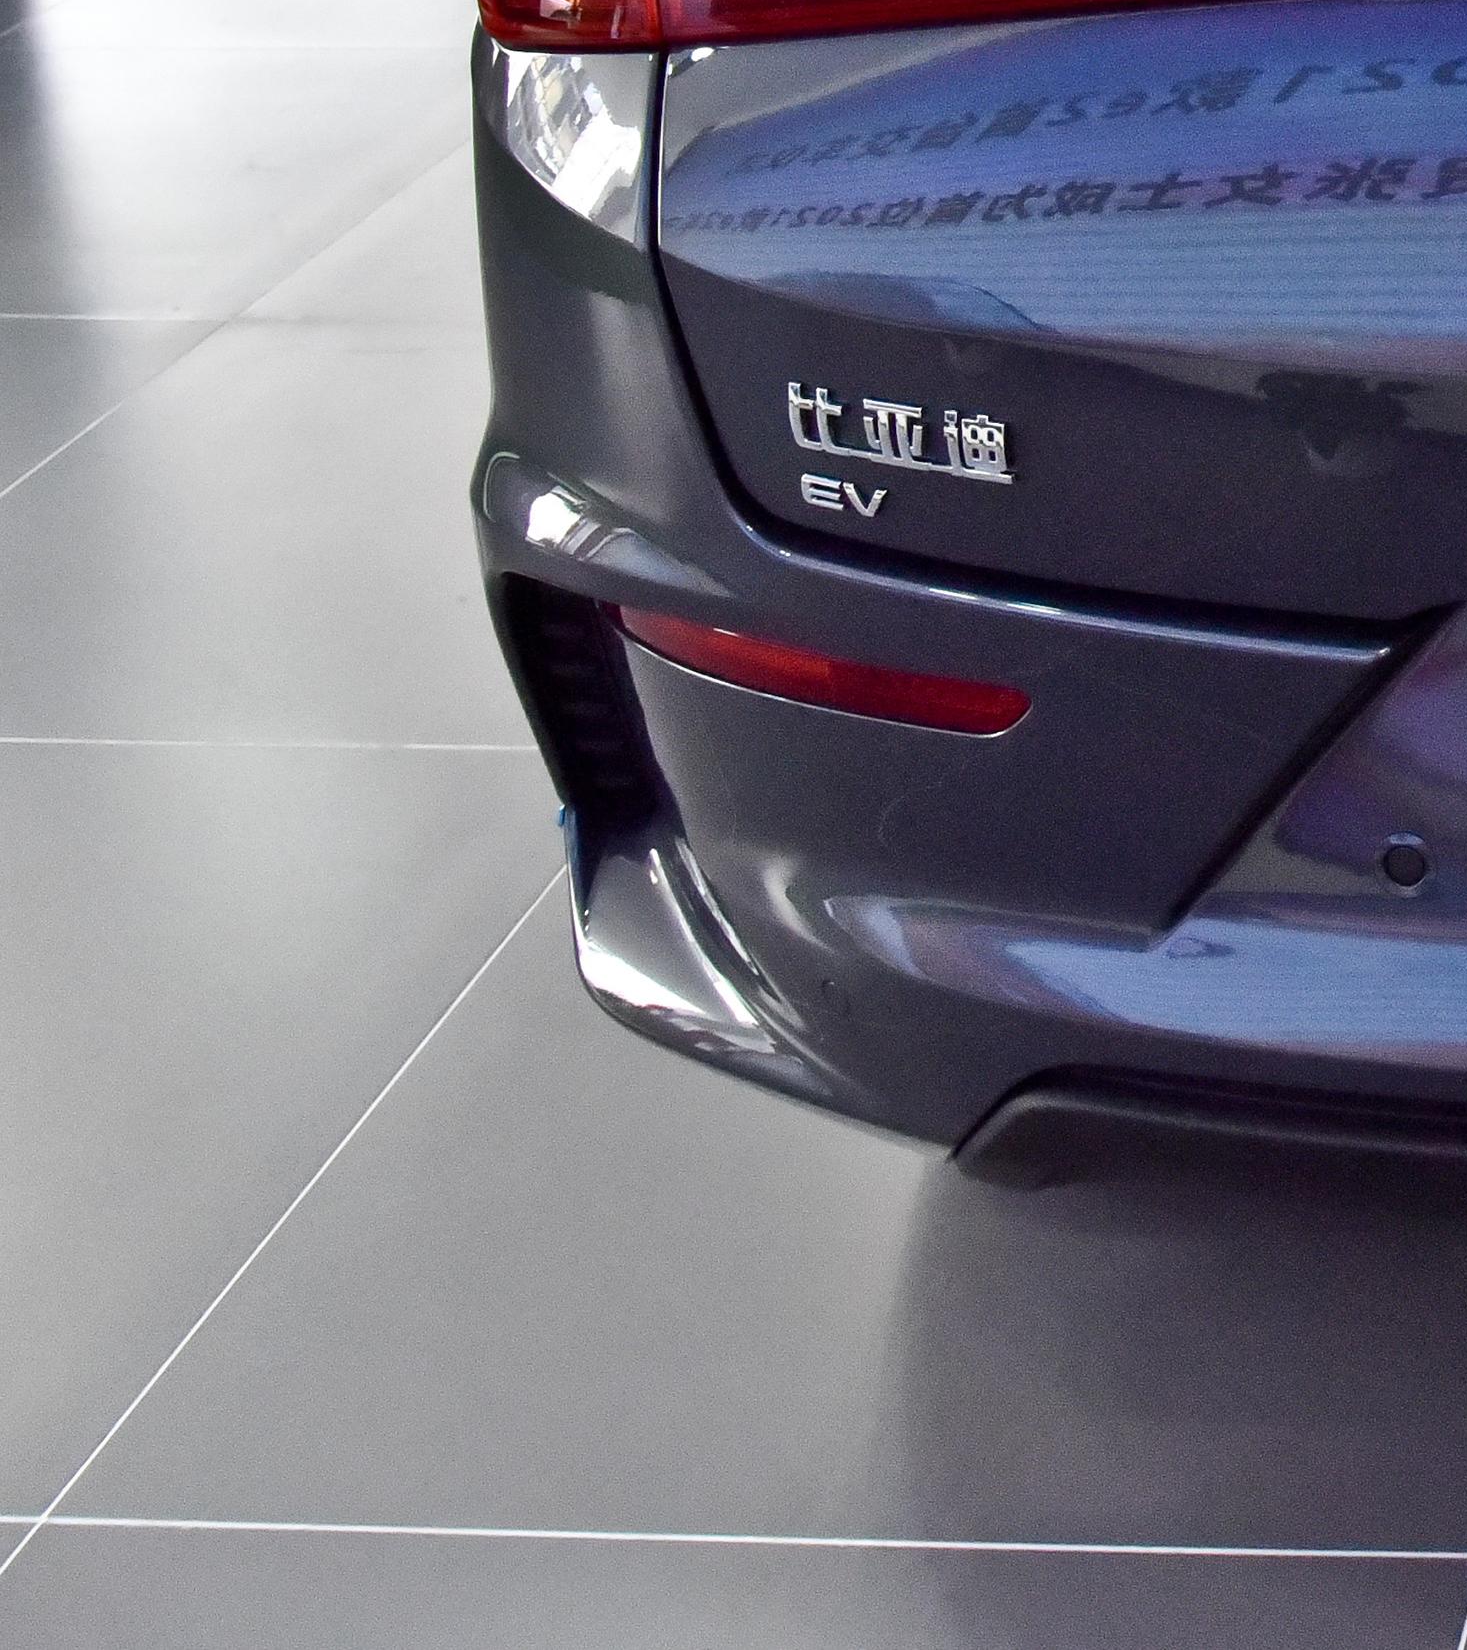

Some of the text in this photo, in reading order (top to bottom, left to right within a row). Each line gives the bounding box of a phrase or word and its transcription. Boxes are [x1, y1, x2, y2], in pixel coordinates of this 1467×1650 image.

[788, 382, 1013, 484] 比亚迪
[801, 473, 888, 517] EV
